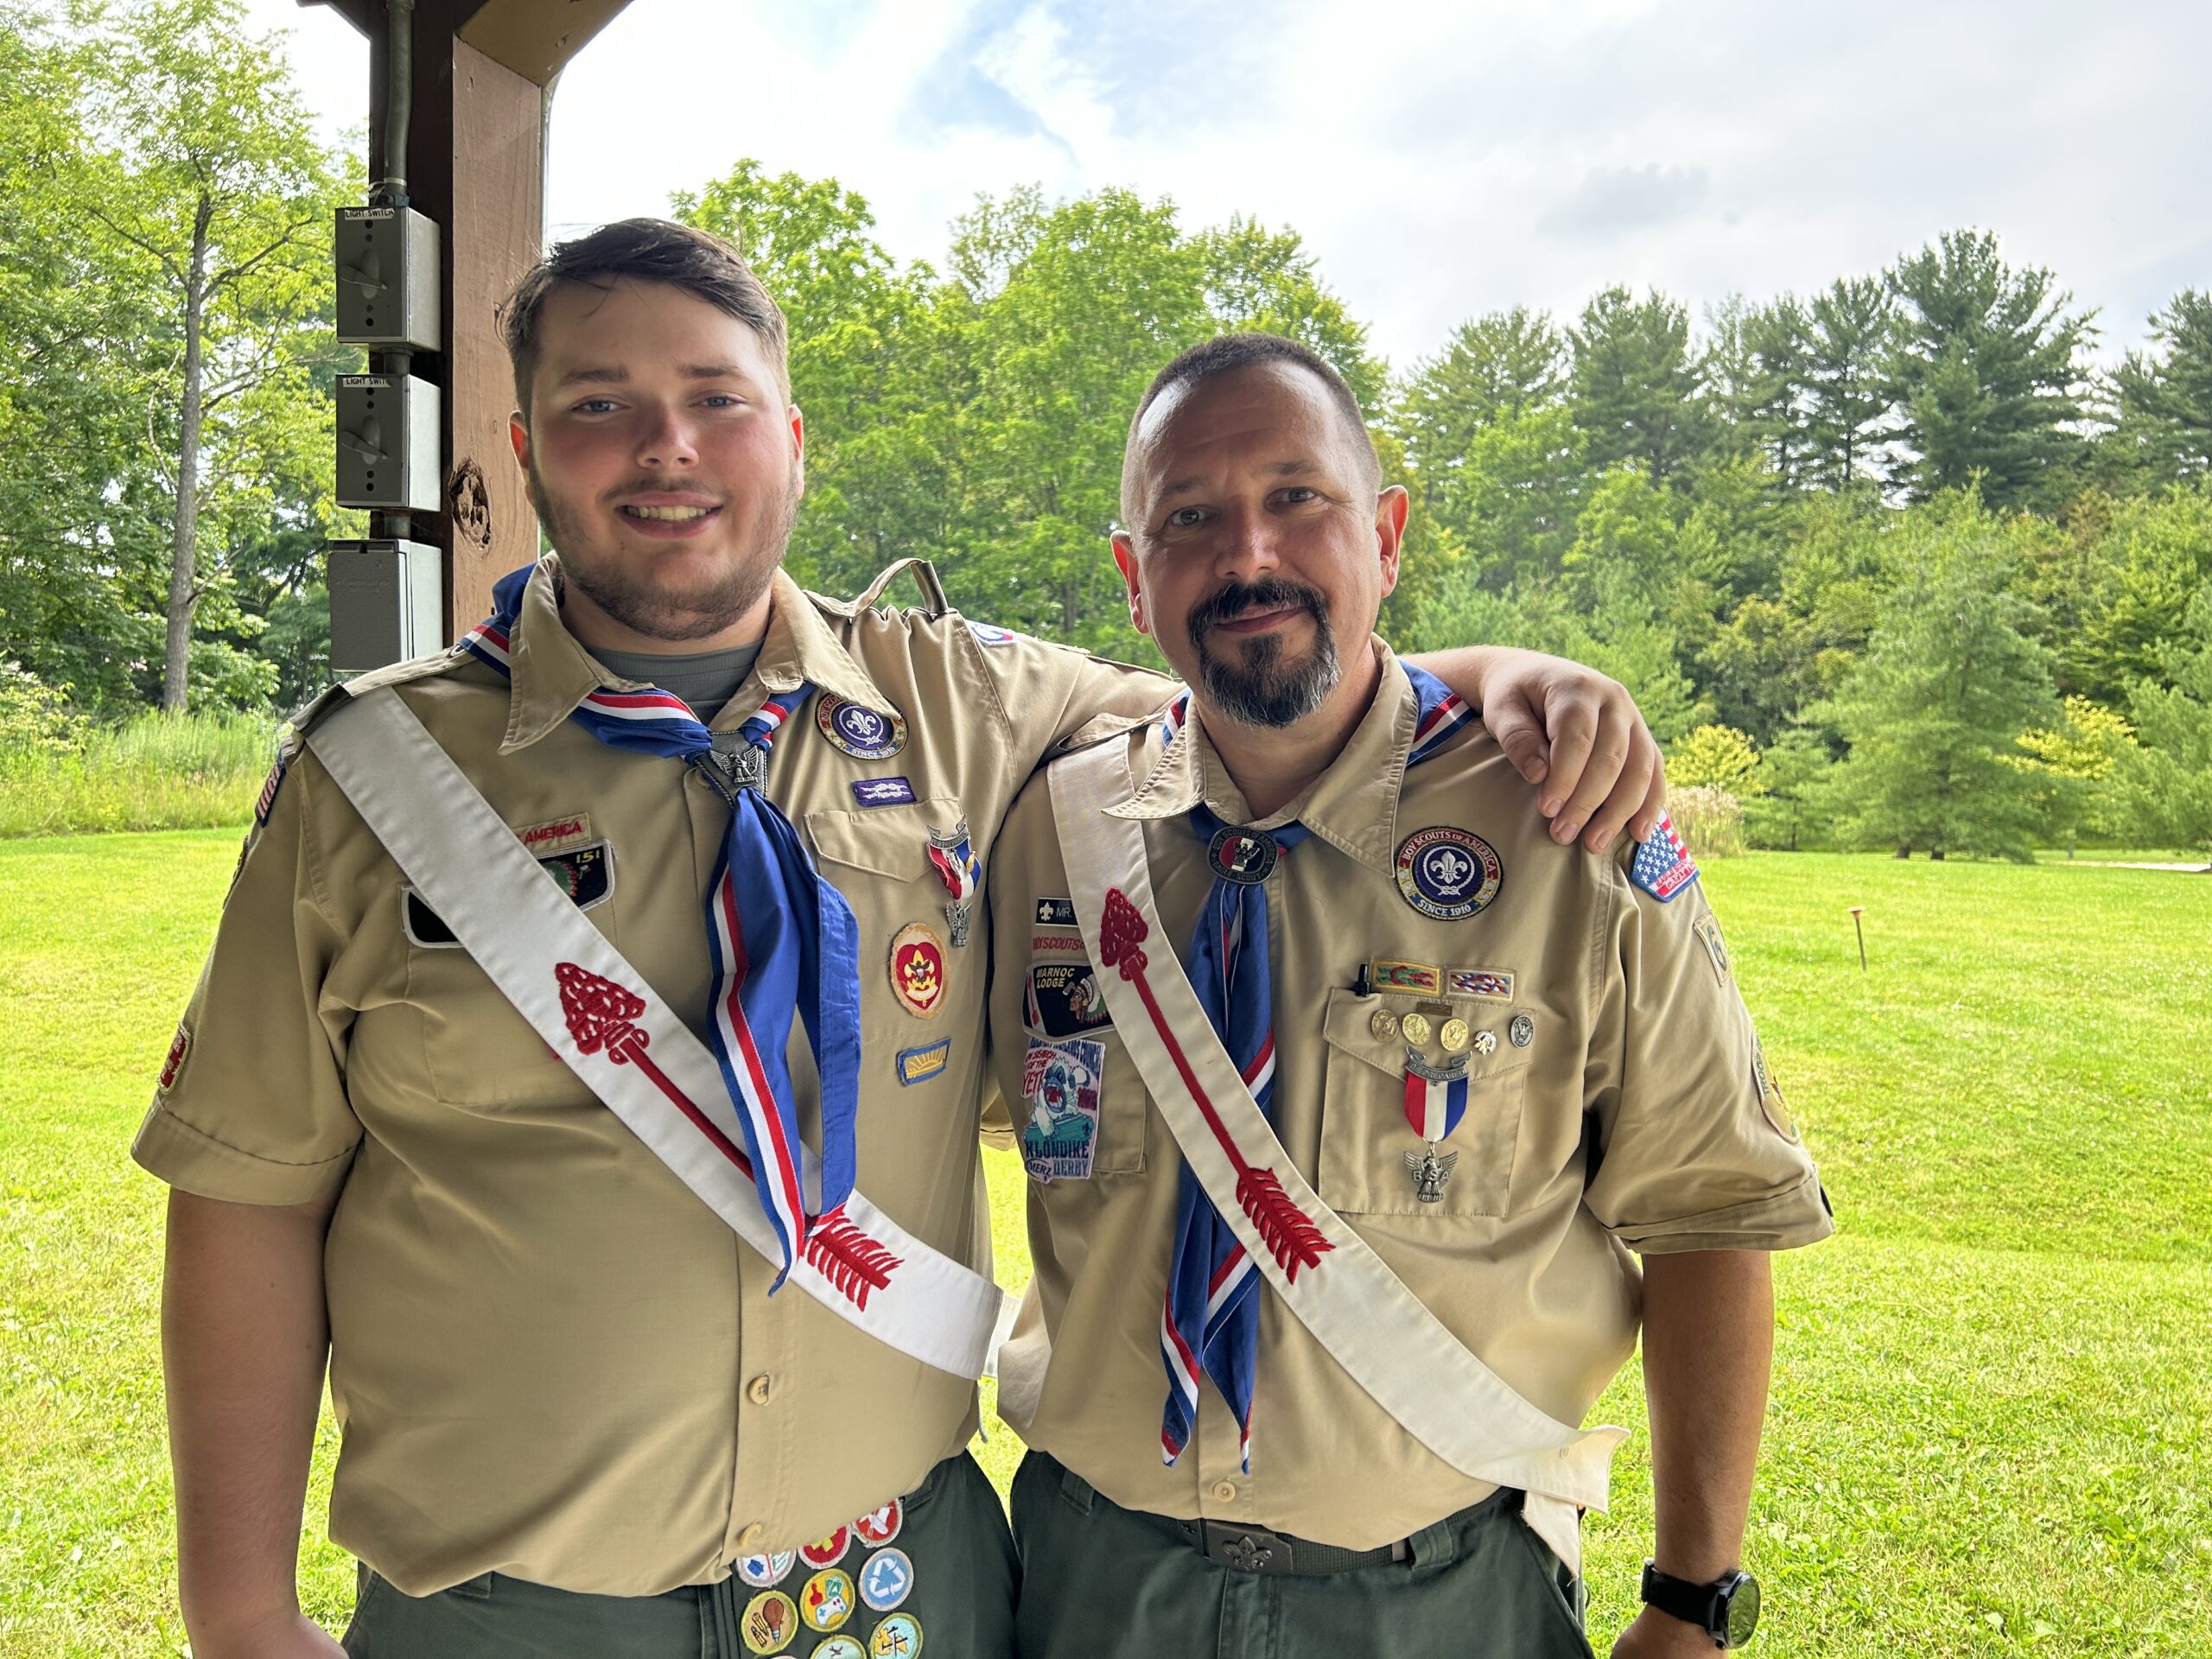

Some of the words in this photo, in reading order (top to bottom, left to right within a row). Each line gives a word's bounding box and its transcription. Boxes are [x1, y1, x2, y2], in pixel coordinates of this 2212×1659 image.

[368, 208, 394, 217] SWITCH
[369, 377, 385, 385] SWIT
[851, 747, 878, 758] SINCE
[524, 821, 582, 844] AMERICA
[1222, 828, 1251, 837] SCOUTS
[1258, 835, 1275, 865] AMERICA
[1402, 842, 1417, 861] BOY
[1414, 830, 1452, 846] SCOUTS
[1461, 836, 1497, 873] AMERICA
[575, 849, 601, 864] 151
[1236, 873, 1262, 881] SCOUT
[1056, 906, 1072, 918] MR.
[1417, 899, 1448, 917] SINCE
[1449, 904, 1472, 916] 1910
[1042, 936, 1081, 950] SCOUTS
[1707, 925, 1727, 971] 6
[1036, 967, 1076, 978] MARNOC
[1036, 977, 1065, 989] LODGE
[1756, 1052, 1770, 1096] TROOP
[1026, 1140, 1090, 1159] KLONDIKE
[1052, 1160, 1089, 1176] DERBY
